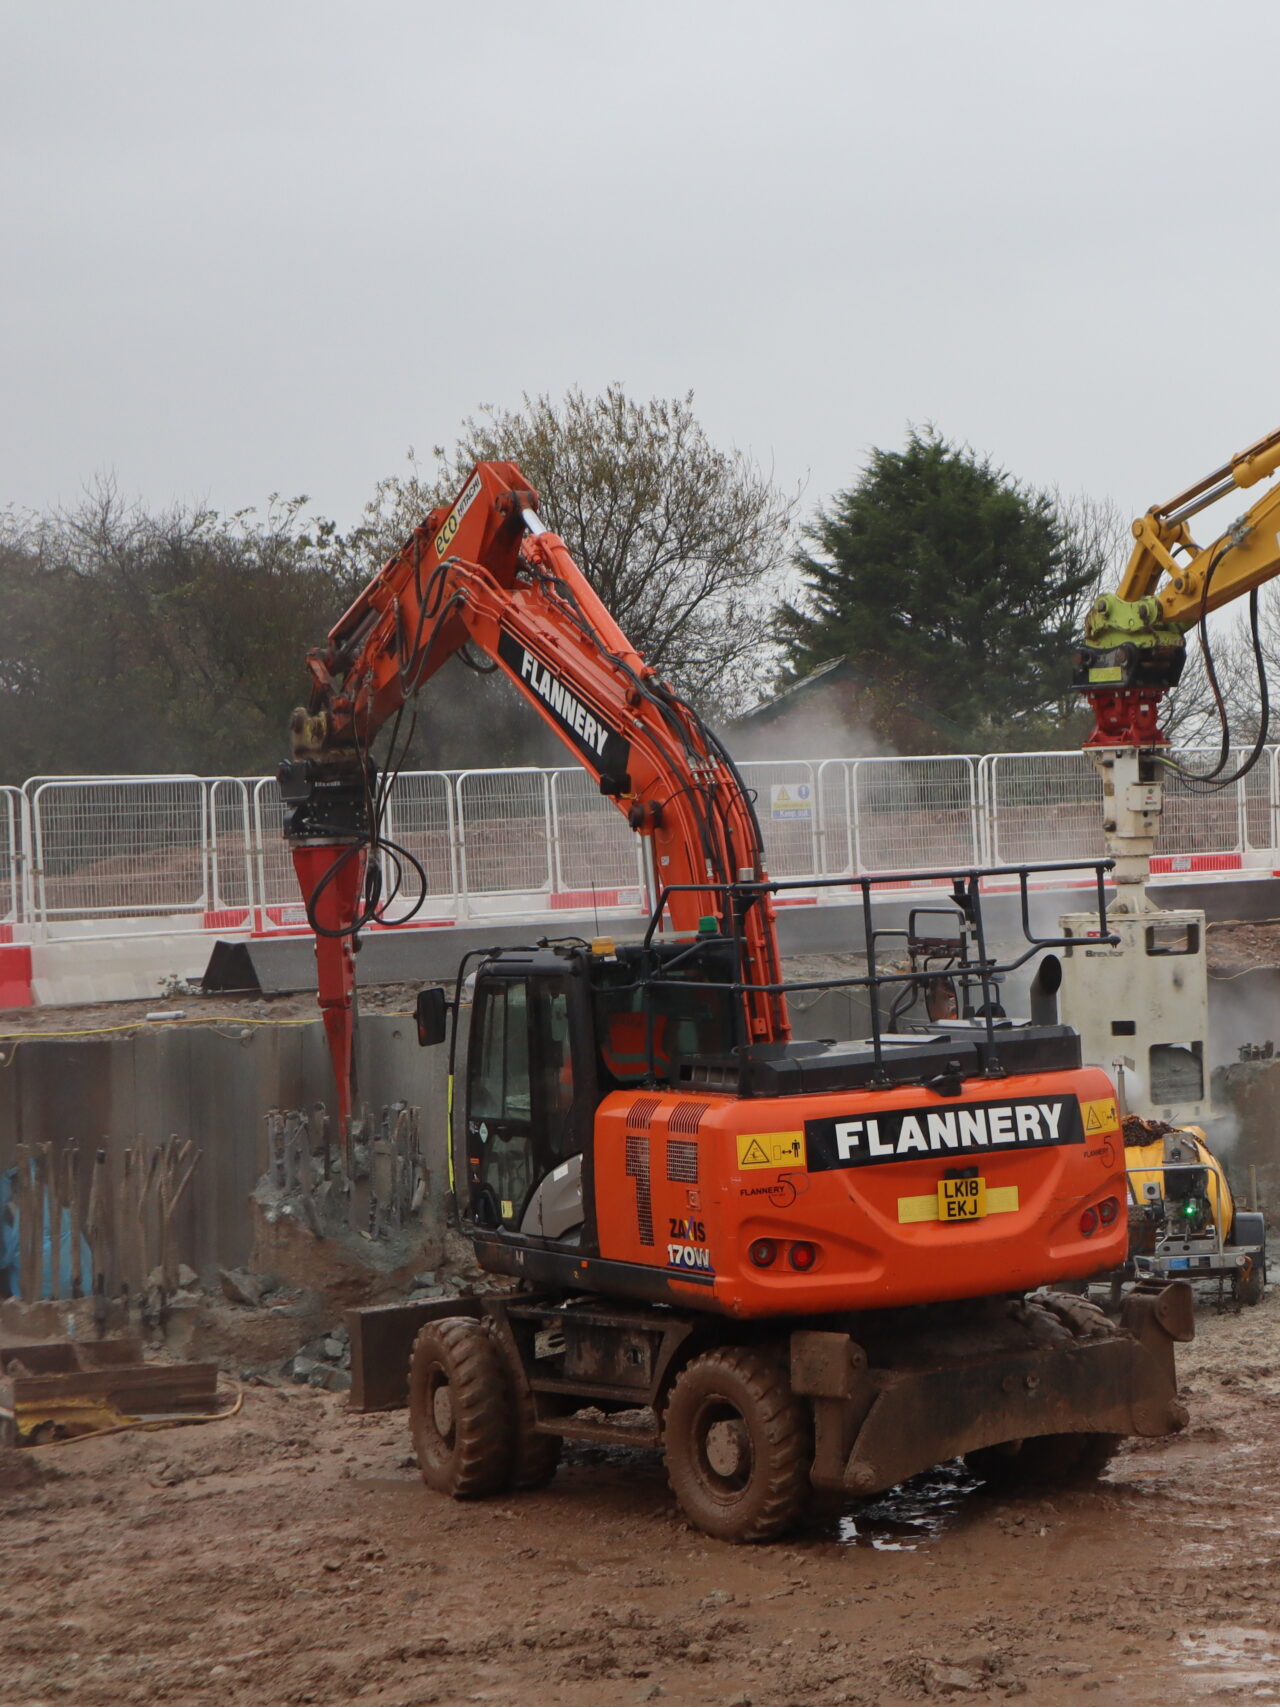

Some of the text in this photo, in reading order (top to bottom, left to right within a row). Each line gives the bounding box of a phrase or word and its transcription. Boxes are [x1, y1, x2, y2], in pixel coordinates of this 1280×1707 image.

[457, 478, 481, 517] HITACHI
[521, 648, 609, 757] FLANNERY
[834, 1102, 1063, 1160] FLANNERY
[1083, 1147, 1108, 1158] FLANNERY
[739, 1186, 784, 1196] FLANNERY
[944, 1180, 979, 1199] LK18
[947, 1201, 978, 1218] EKJ
[669, 1216, 706, 1242] ZAXIS
[667, 1244, 710, 1268] 170W
